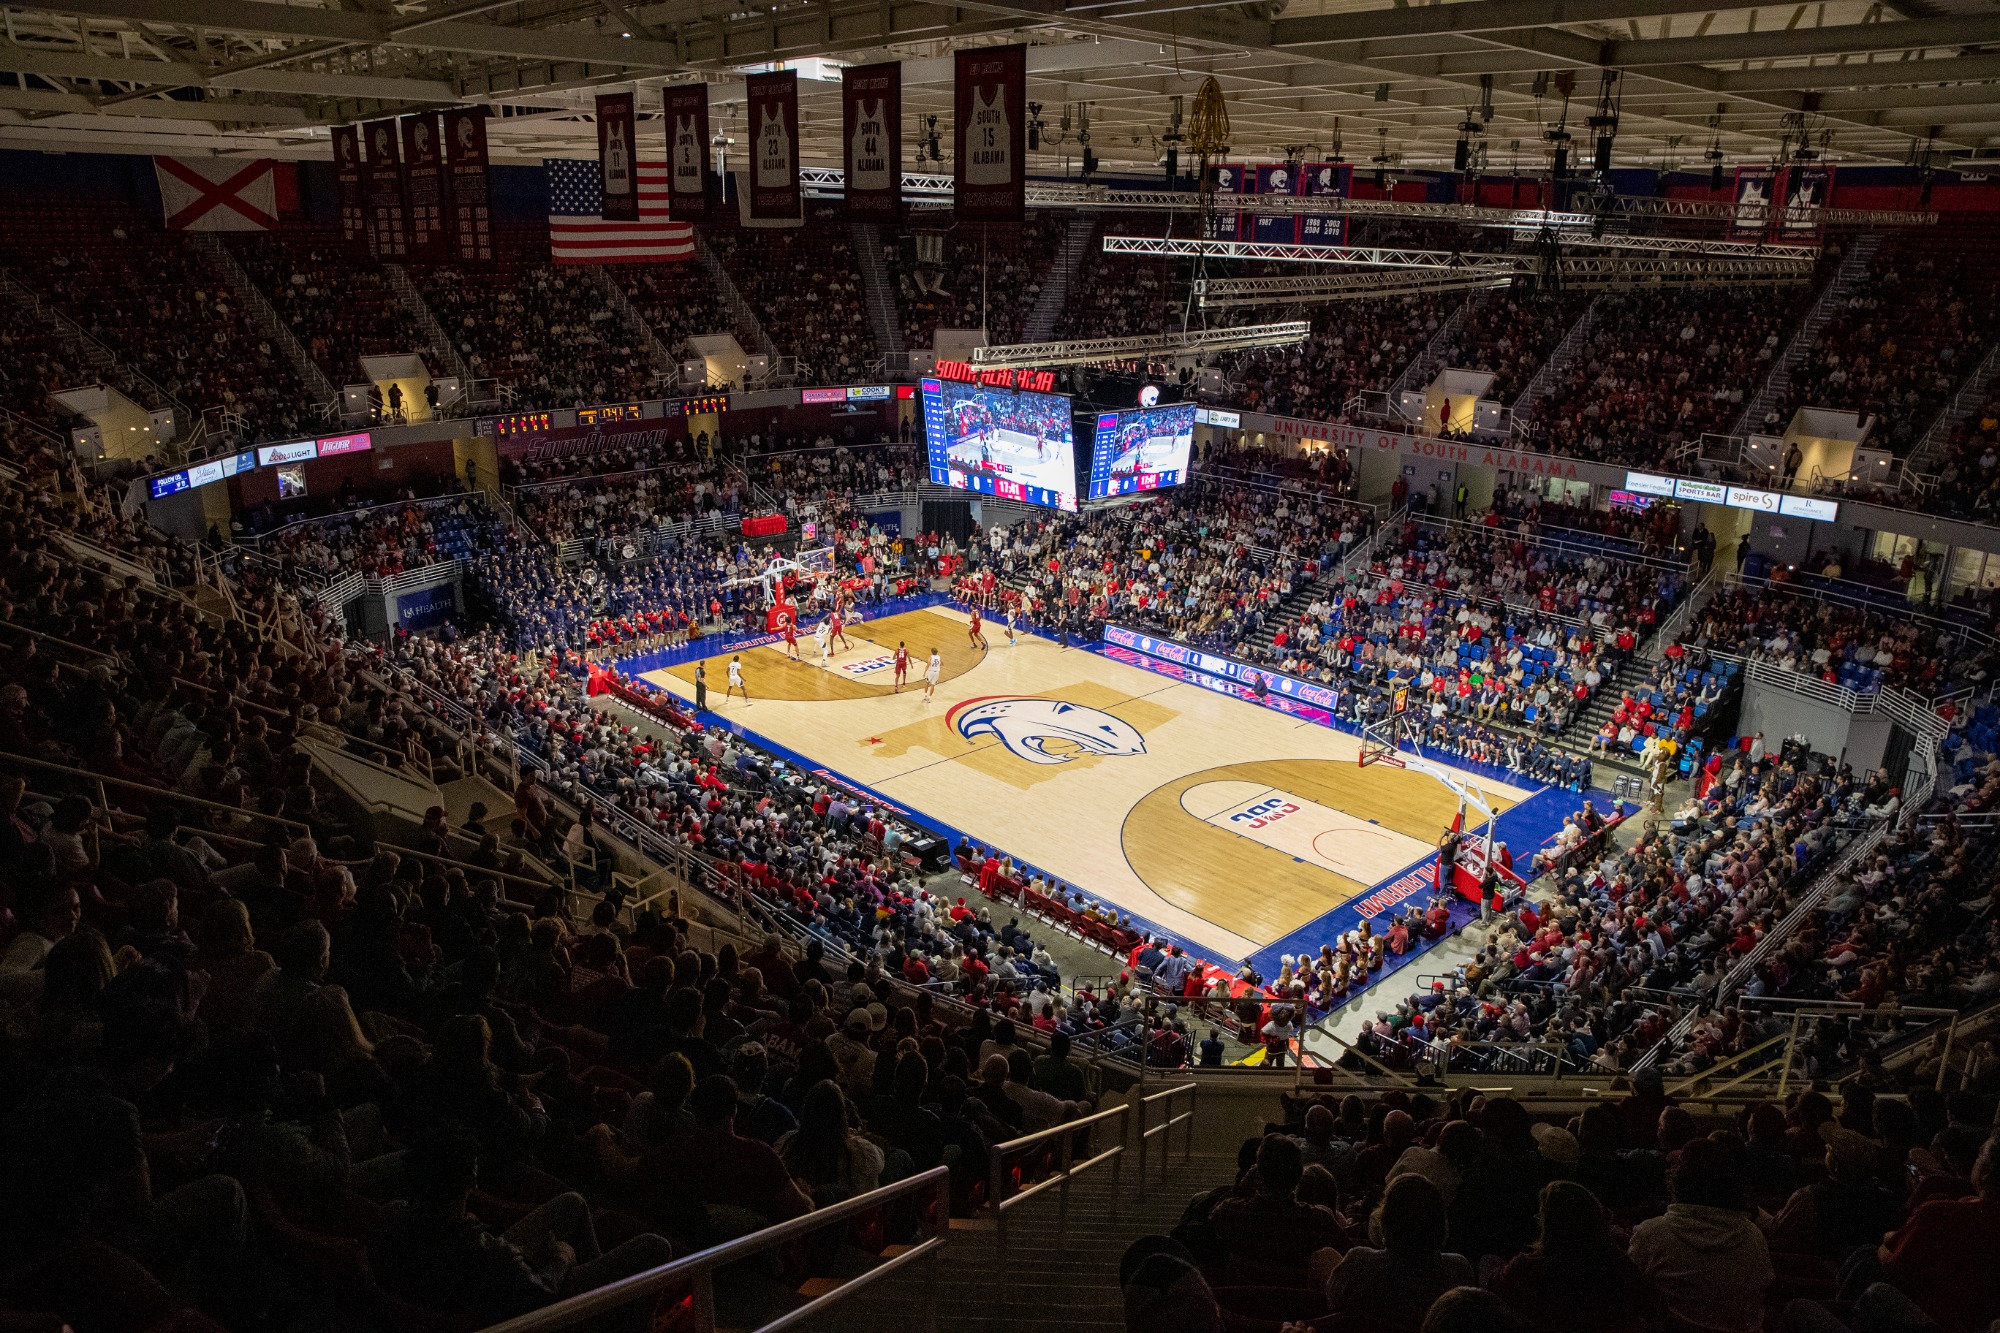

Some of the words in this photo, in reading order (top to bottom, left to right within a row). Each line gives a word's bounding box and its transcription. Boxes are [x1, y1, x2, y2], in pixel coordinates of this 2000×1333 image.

[977, 110, 1001, 126] SOUTH
[764, 125, 781, 137] SOUTH
[861, 122, 881, 136] SOUTH
[679, 134, 694, 146] SOUTH
[983, 128, 995, 147] 15
[609, 139, 624, 151] SOUTH
[768, 140, 779, 156] 23
[865, 138, 877, 156] 44
[612, 152, 621, 167] 11
[684, 147, 690, 163] 5
[973, 151, 1005, 164] ALABAMA
[763, 159, 786, 170] ALABAMA
[857, 159, 885, 171] ALABAMA
[608, 169, 627, 180] ALABAMA
[677, 166, 698, 177] ALABAMA
[1258, 218, 1273, 226] 1987
[935, 359, 977, 382] SOUTH
[603, 408, 622, 417] 17:41
[588, 416, 594, 424] 0
[321, 439, 350, 452] JAGUAR
[1274, 422, 1365, 445] UNIVERSITY
[1377, 436, 1399, 450] OF
[1412, 443, 1468, 461] SOUTH
[1482, 452, 1577, 478] ALABAMA
[291, 449, 311, 458] LIGHT
[157, 476, 175, 486] FOLLOW
[973, 476, 980, 490] 0
[1167, 473, 1173, 482] 4
[998, 480, 1020, 496] 17:41
[1678, 487, 1705, 496] SPORTS
[1706, 491, 1721, 499] BAR
[1042, 490, 1049, 505] 4
[1733, 492, 1760, 503] spire
[1805, 499, 1812, 508] R
[415, 598, 452, 615] HEALTH
[1107, 628, 1135, 647] Coca-Cola
[1155, 641, 1185, 662] Coca-Cola
[1191, 653, 1198, 664] 4
[1298, 684, 1333, 706] Coca-Cola
